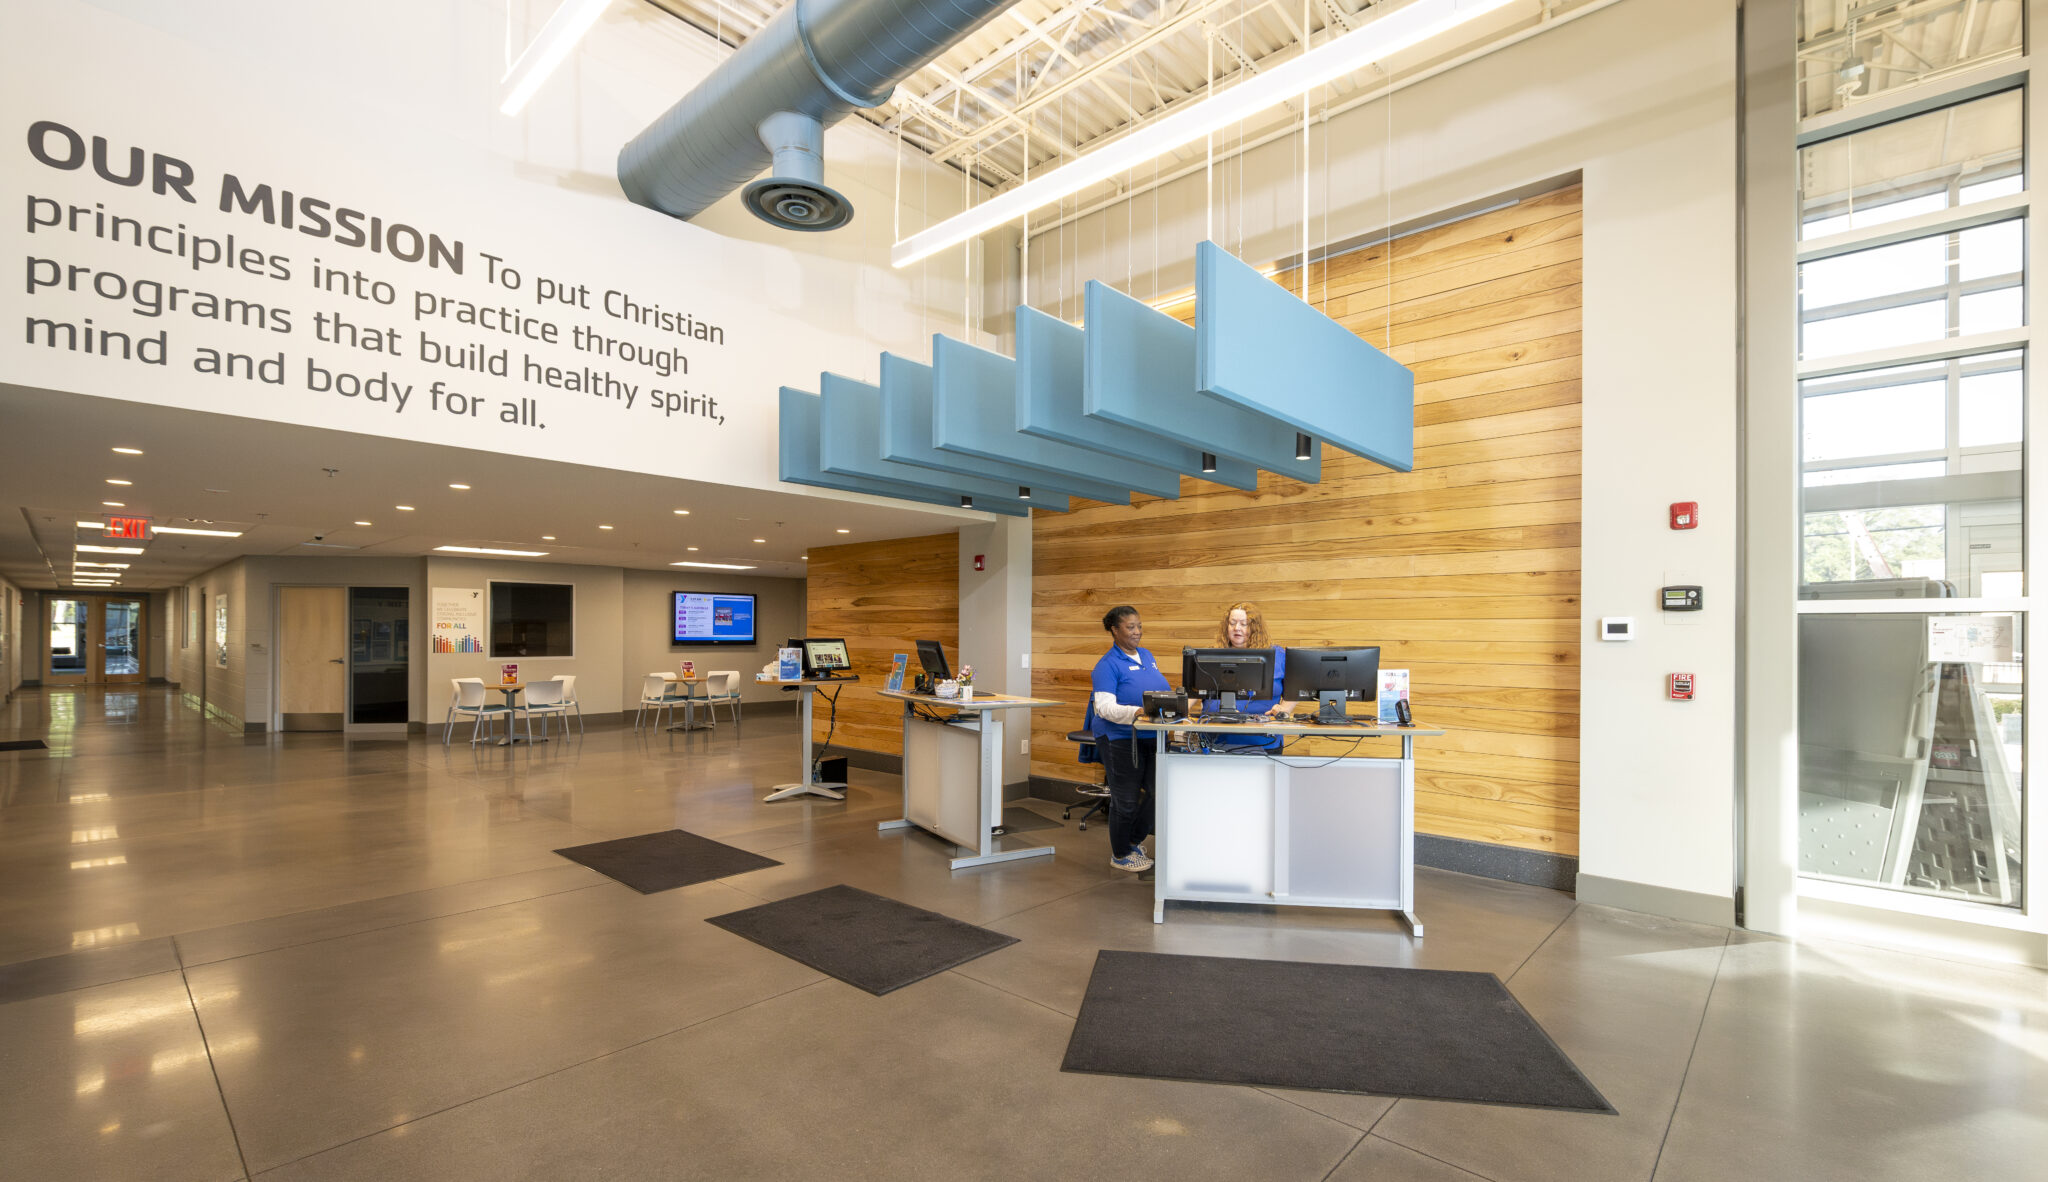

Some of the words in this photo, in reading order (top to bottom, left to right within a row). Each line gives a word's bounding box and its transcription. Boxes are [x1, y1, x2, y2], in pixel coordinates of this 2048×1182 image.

[27, 121, 197, 203] OUR
[220, 174, 464, 275] MISSION
[480, 253, 521, 290] To
[538, 278, 590, 310] put
[605, 290, 724, 346] Christian
[27, 195, 291, 281] principles
[314, 258, 396, 305] into
[416, 291, 559, 345] practice
[572, 326, 688, 377] through
[27, 256, 292, 334] programs
[314, 311, 402, 357] that
[421, 332, 508, 378] build
[525, 354, 639, 410] healthy
[651, 388, 725, 425] spirit,
[27, 317, 168, 366] mind
[194, 347, 285, 386] and
[308, 357, 414, 414] body
[430, 382, 485, 417] for
[500, 398, 546, 430] all.
[111, 517, 147, 538] EXIT
